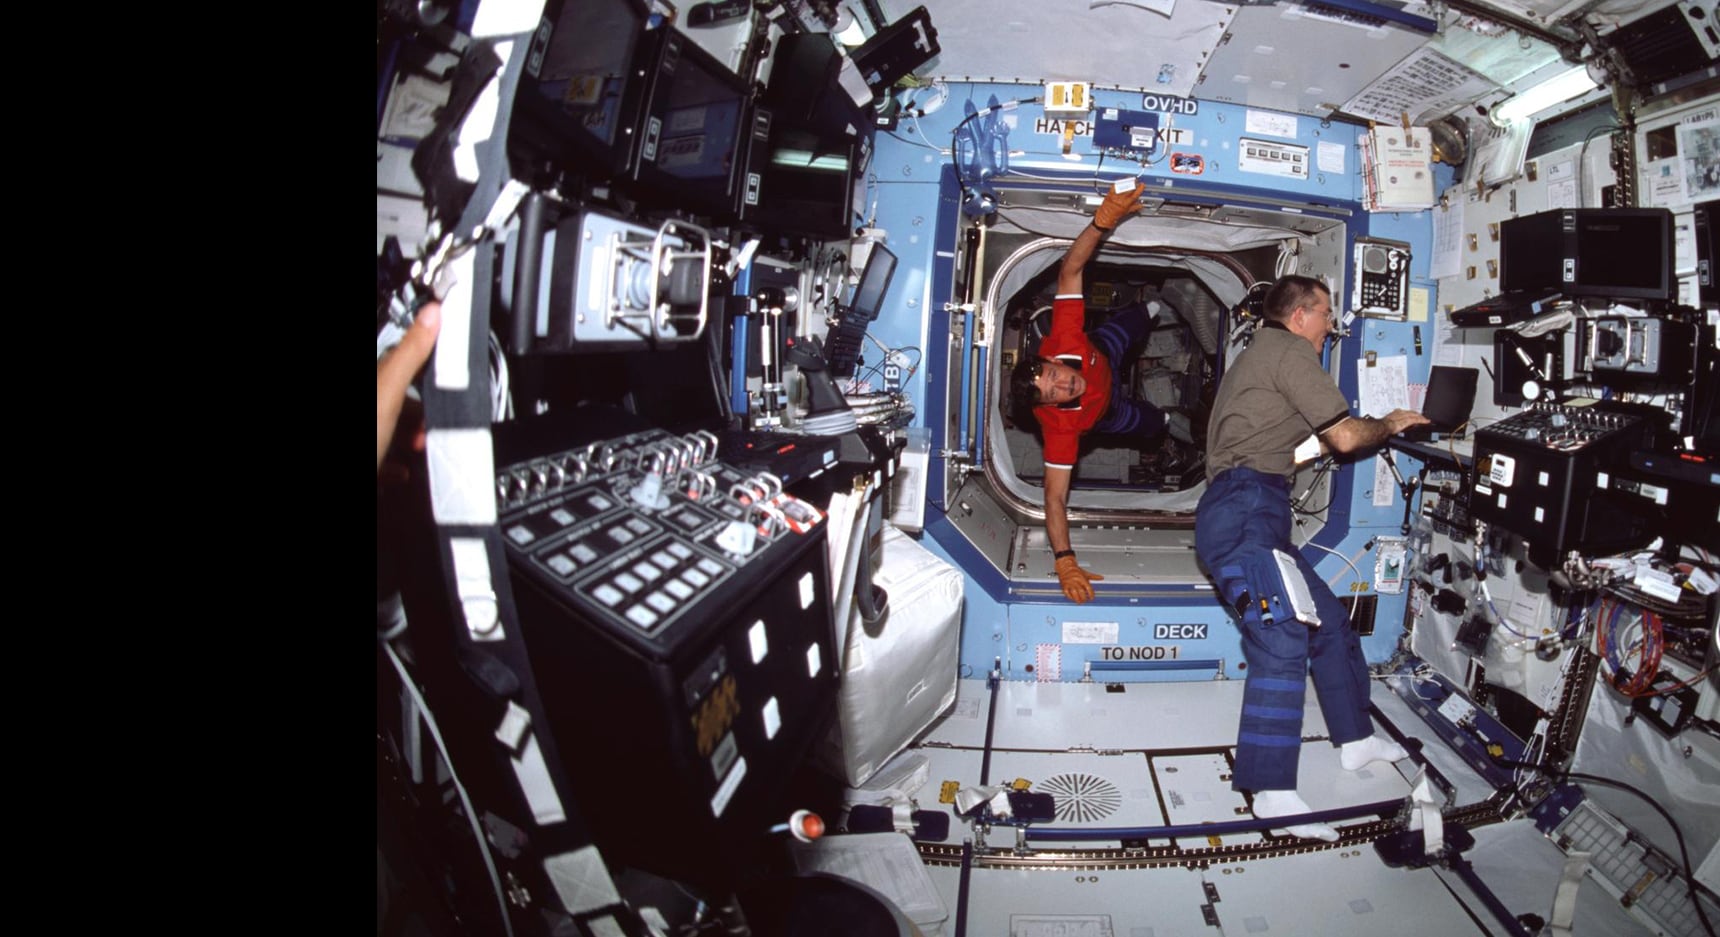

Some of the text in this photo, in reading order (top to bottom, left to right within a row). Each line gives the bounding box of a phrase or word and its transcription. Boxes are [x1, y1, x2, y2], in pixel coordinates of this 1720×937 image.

[1143, 96, 1197, 115] OVHD
[1156, 127, 1184, 143] XIT
[1156, 624, 1206, 639] DECK
[1101, 646, 1177, 660] TO NOD 1
